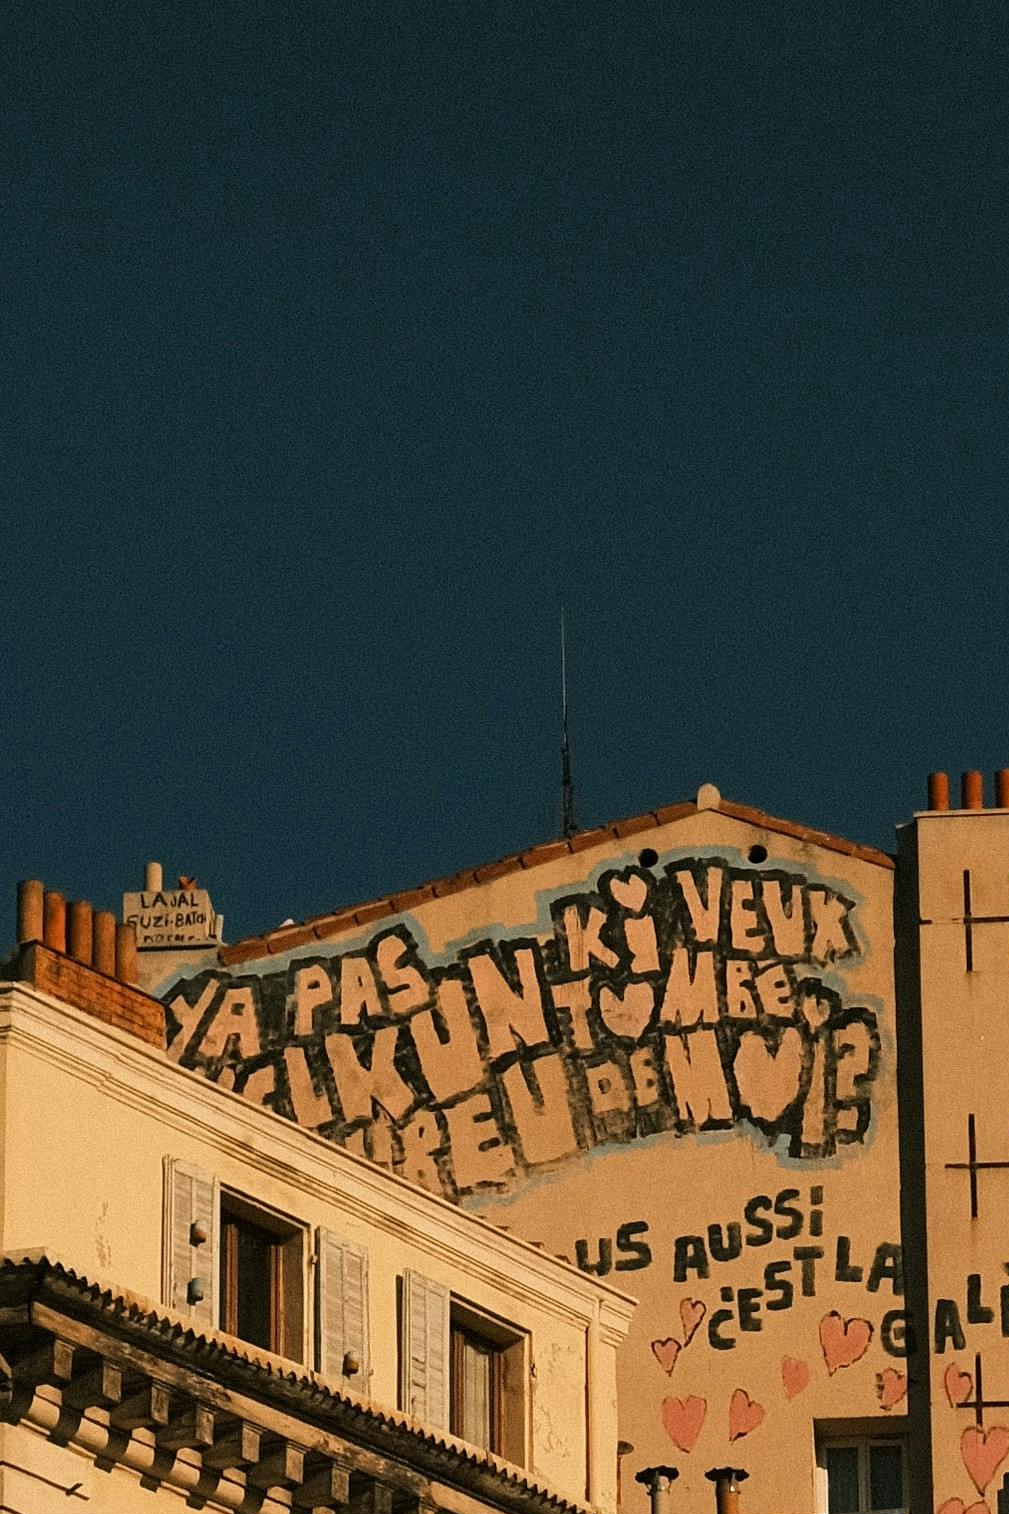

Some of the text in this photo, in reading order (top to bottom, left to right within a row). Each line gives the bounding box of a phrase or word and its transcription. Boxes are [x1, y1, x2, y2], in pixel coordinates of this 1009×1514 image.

[664, 856, 861, 964] VEUX
[163, 924, 432, 1066] YA PAS
[835, 1235, 905, 1297] LA
